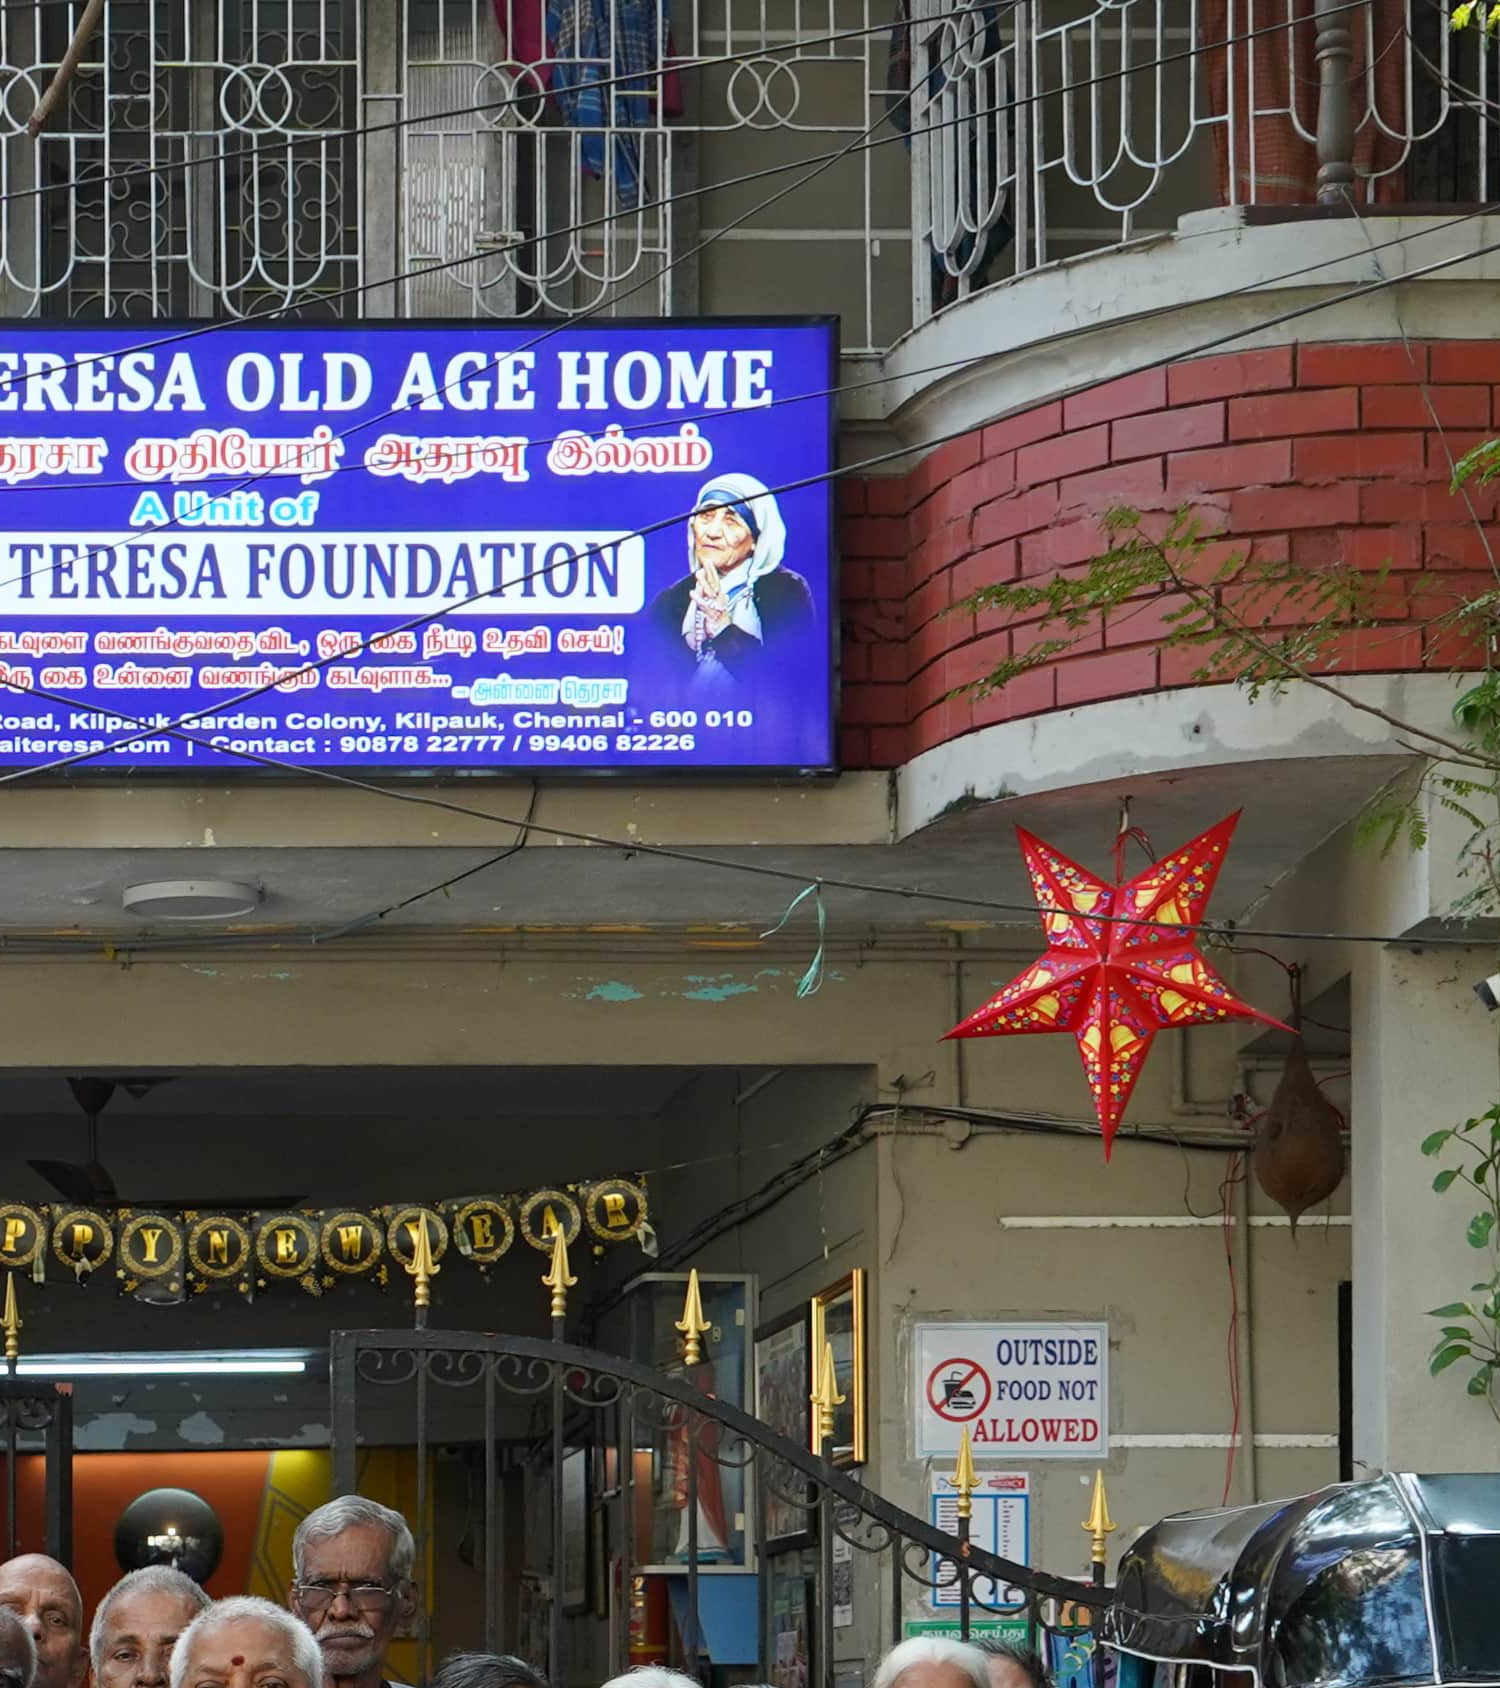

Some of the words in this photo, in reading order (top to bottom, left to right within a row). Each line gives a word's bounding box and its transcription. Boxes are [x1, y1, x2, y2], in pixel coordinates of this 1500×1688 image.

[226, 351, 373, 412] OLD
[391, 351, 537, 412] AGE
[557, 349, 774, 411] HOME
[128, 427, 341, 482] முதியோர்
[368, 437, 528, 481] ஆதரவு
[550, 426, 711, 473] இல்லம்
[132, 493, 164, 524] A
[175, 491, 261, 524] Unit
[272, 493, 318, 524] of
[9, 541, 230, 600] TERESA
[246, 540, 622, 600] FOUNDATION
[70, 711, 171, 735] Kilpauk
[180, 711, 279, 730] Garden
[286, 711, 386, 734] Colony,
[395, 711, 504, 735] Kilpauk,
[513, 710, 624, 730] Chennai
[650, 711, 697, 728] 600
[705, 710, 753, 728] 010
[210, 735, 316, 753] Contact
[340, 735, 419, 753] 90878
[427, 735, 505, 753] 22777
[529, 735, 608, 752] 99406
[616, 734, 696, 752] 82226
[208, 1222, 362, 1265] NEW
[996, 1339, 1098, 1366] OUTSIDE
[996, 1380, 1051, 1401] FOOD
[1059, 1380, 1098, 1400] NOT
[972, 1418, 1099, 1442] ALLOWED
